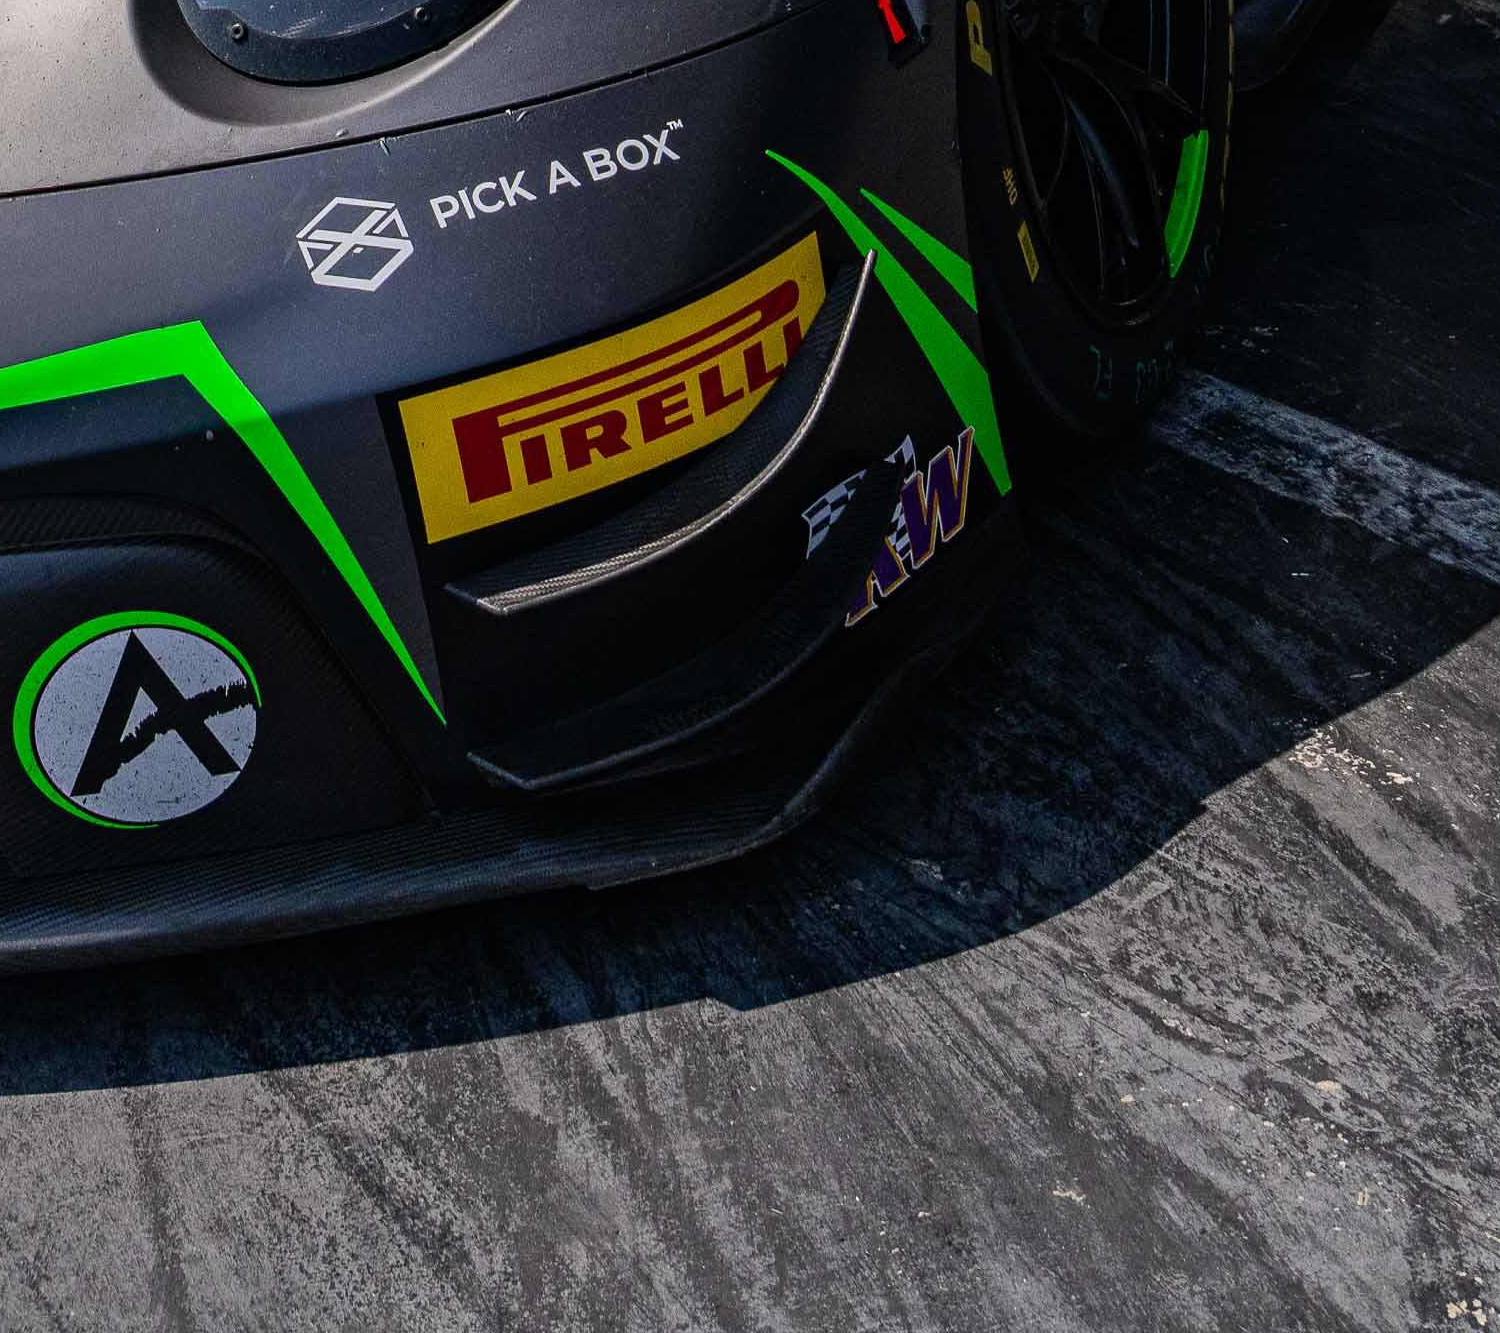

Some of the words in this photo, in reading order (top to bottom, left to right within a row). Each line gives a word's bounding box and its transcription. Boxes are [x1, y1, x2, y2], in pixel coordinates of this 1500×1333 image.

[429, 170, 538, 229] PICK
[549, 159, 582, 195] A
[452, 278, 802, 504] PIRELLI
